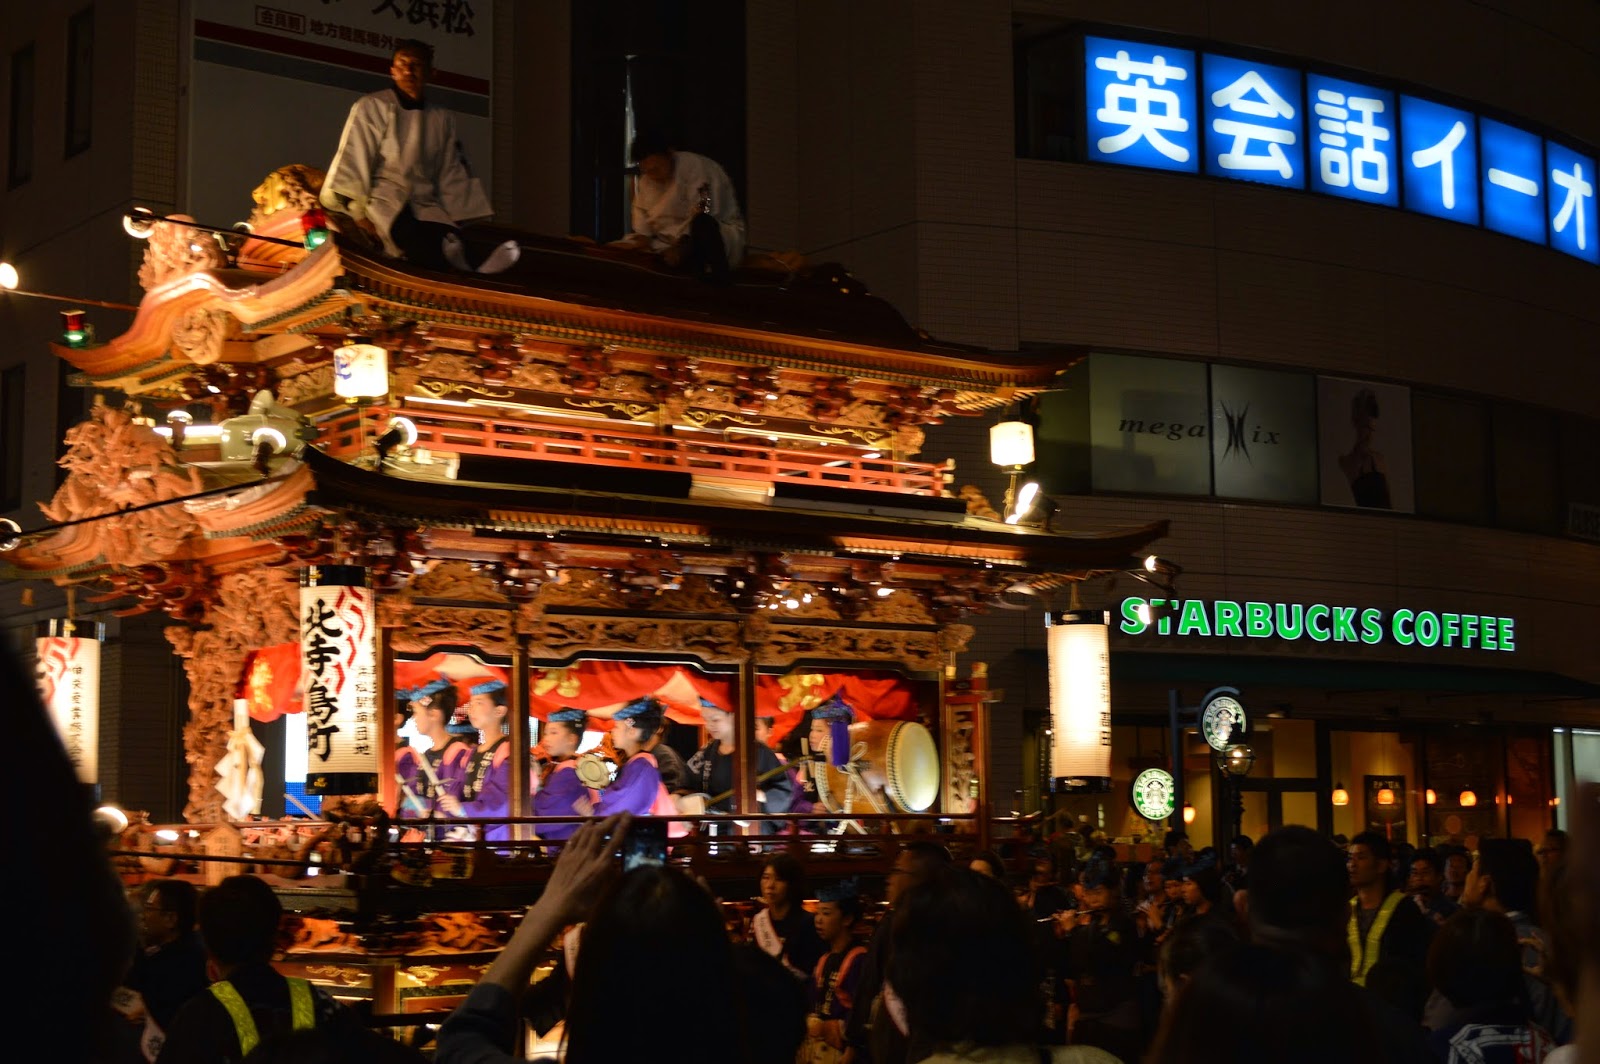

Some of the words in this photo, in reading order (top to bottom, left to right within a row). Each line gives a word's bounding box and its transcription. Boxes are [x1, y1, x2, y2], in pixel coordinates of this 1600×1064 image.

[1095, 50, 1594, 250] 英会話イーオ
[1118, 417, 1206, 442] mega
[1119, 597, 1384, 645] STARBUCKS
[1392, 608, 1516, 652] COFFEE
[306, 598, 343, 762] 北寺島町
